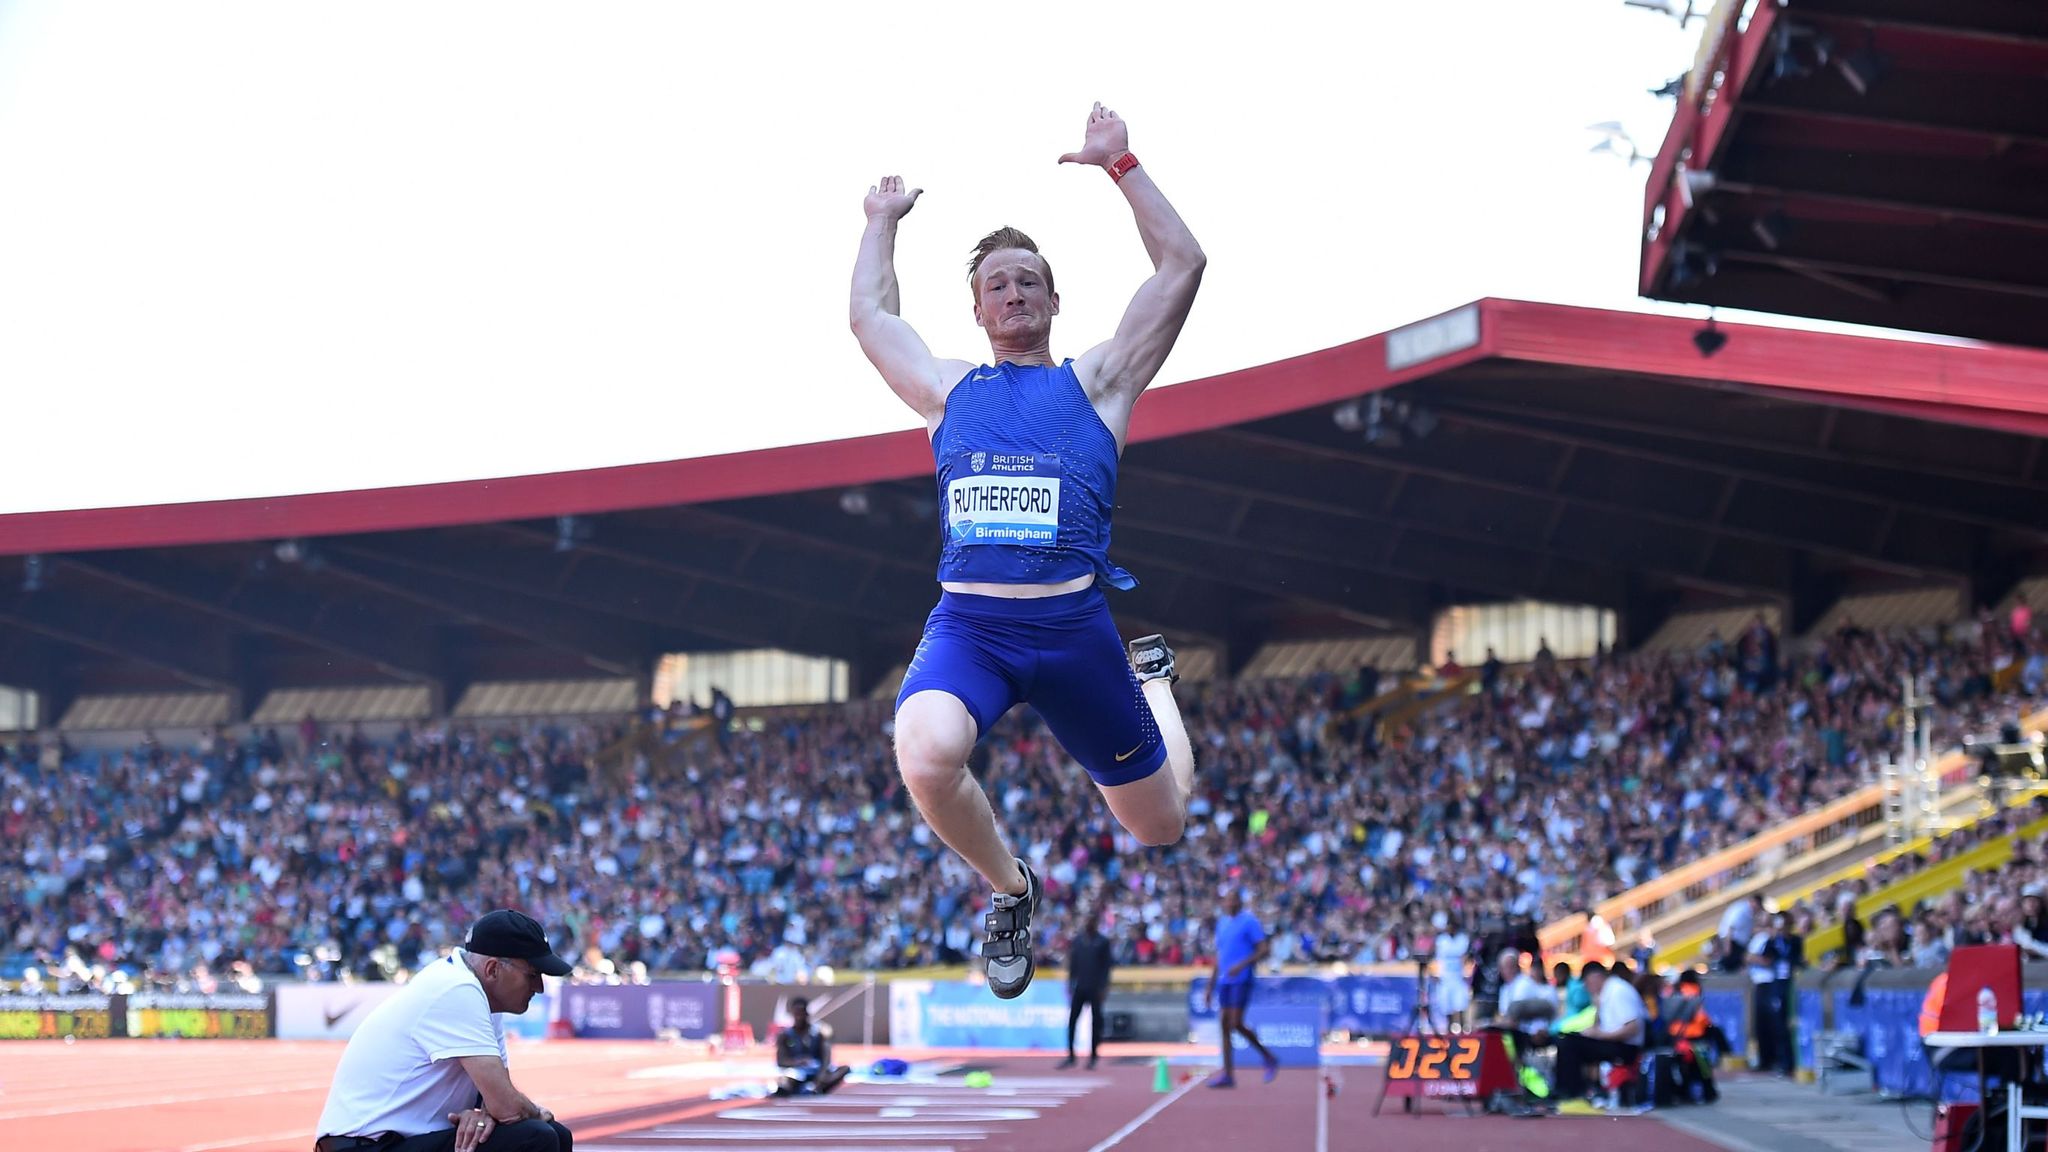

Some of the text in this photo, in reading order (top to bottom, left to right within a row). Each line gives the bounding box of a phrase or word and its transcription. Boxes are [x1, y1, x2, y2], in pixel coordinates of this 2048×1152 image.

[992, 454, 1035, 464] BRITISH
[991, 464, 1035, 472] ATHLETICS
[953, 485, 1052, 514] RUTHERFORD
[975, 527, 1053, 541] Birmingham
